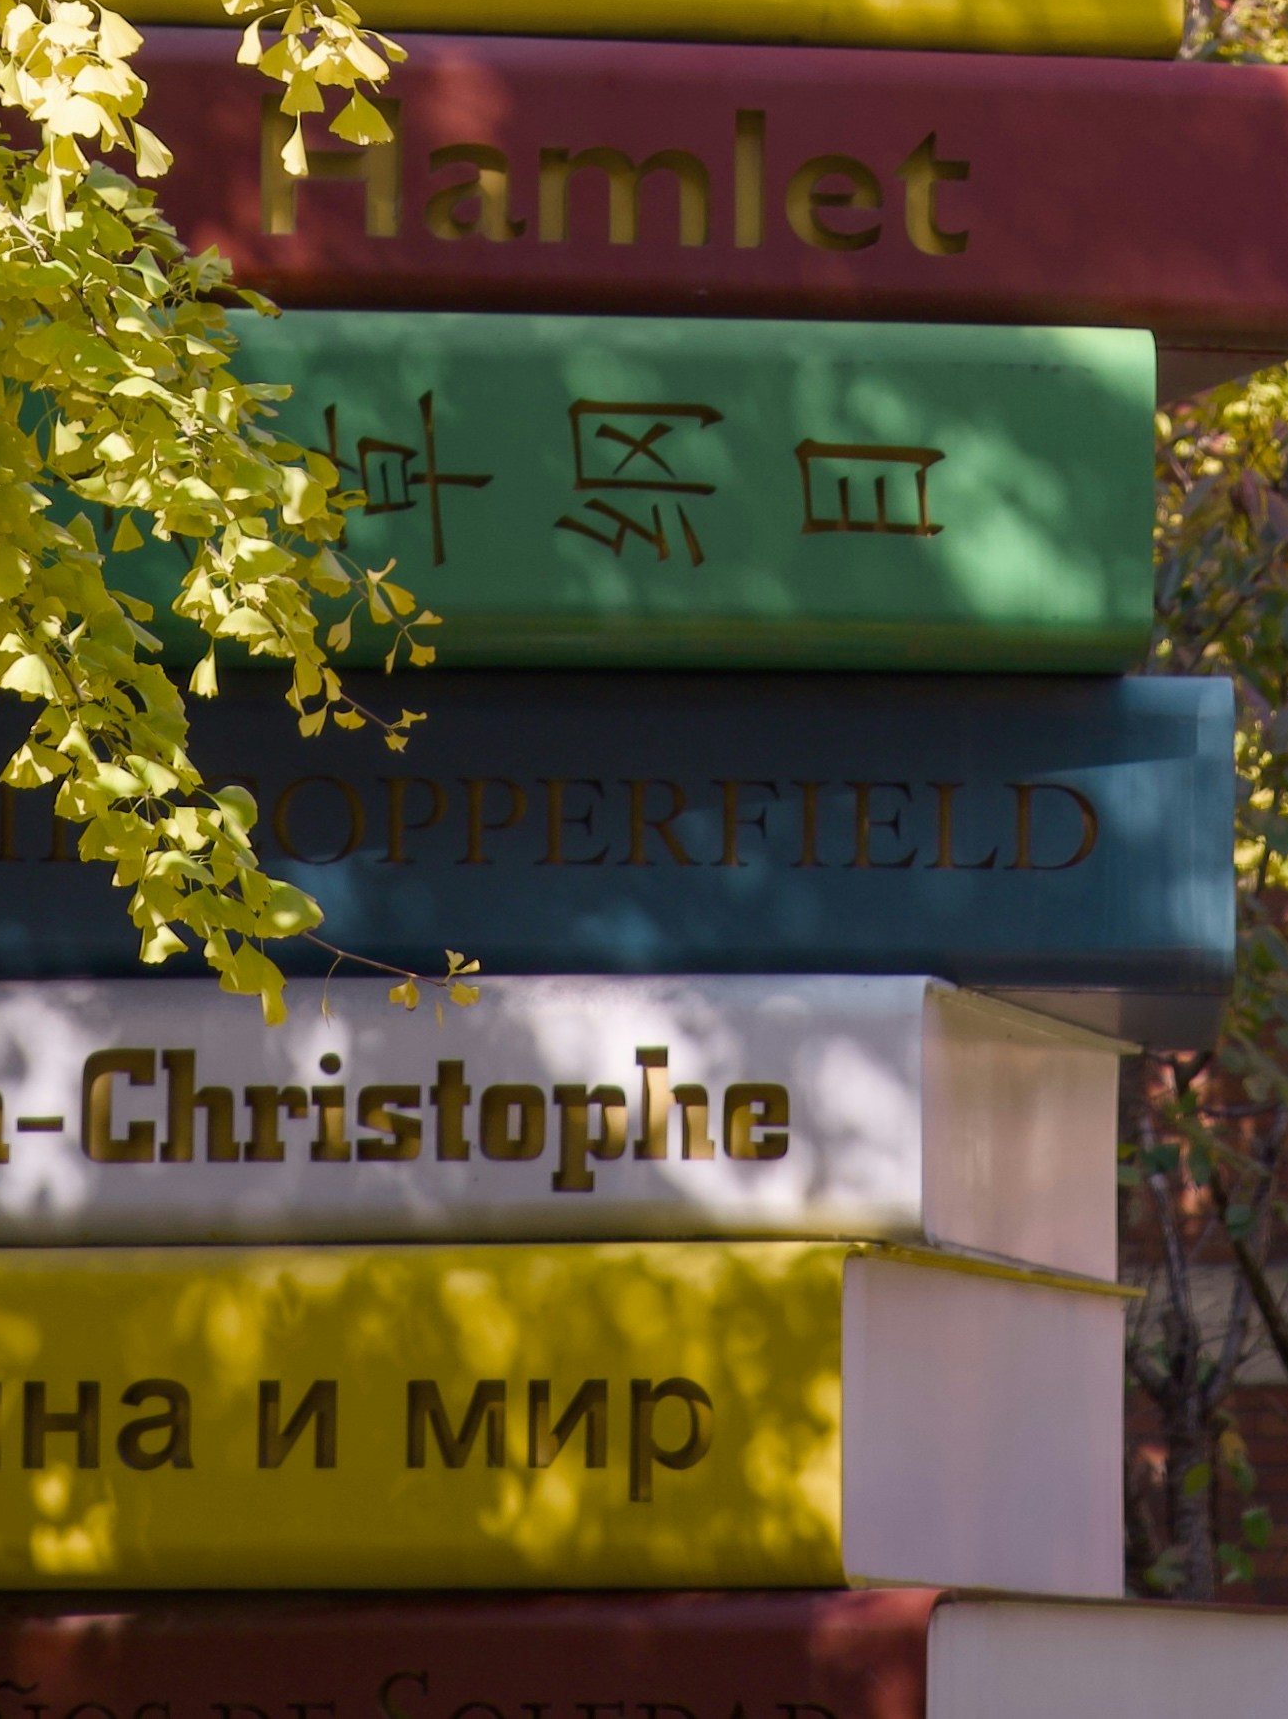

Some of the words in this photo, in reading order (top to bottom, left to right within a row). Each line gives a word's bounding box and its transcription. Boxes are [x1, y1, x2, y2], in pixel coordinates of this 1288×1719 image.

[258, 93, 973, 257] Hamlet
[256, 1377, 340, 1471] и
[404, 1375, 714, 1505] мир
